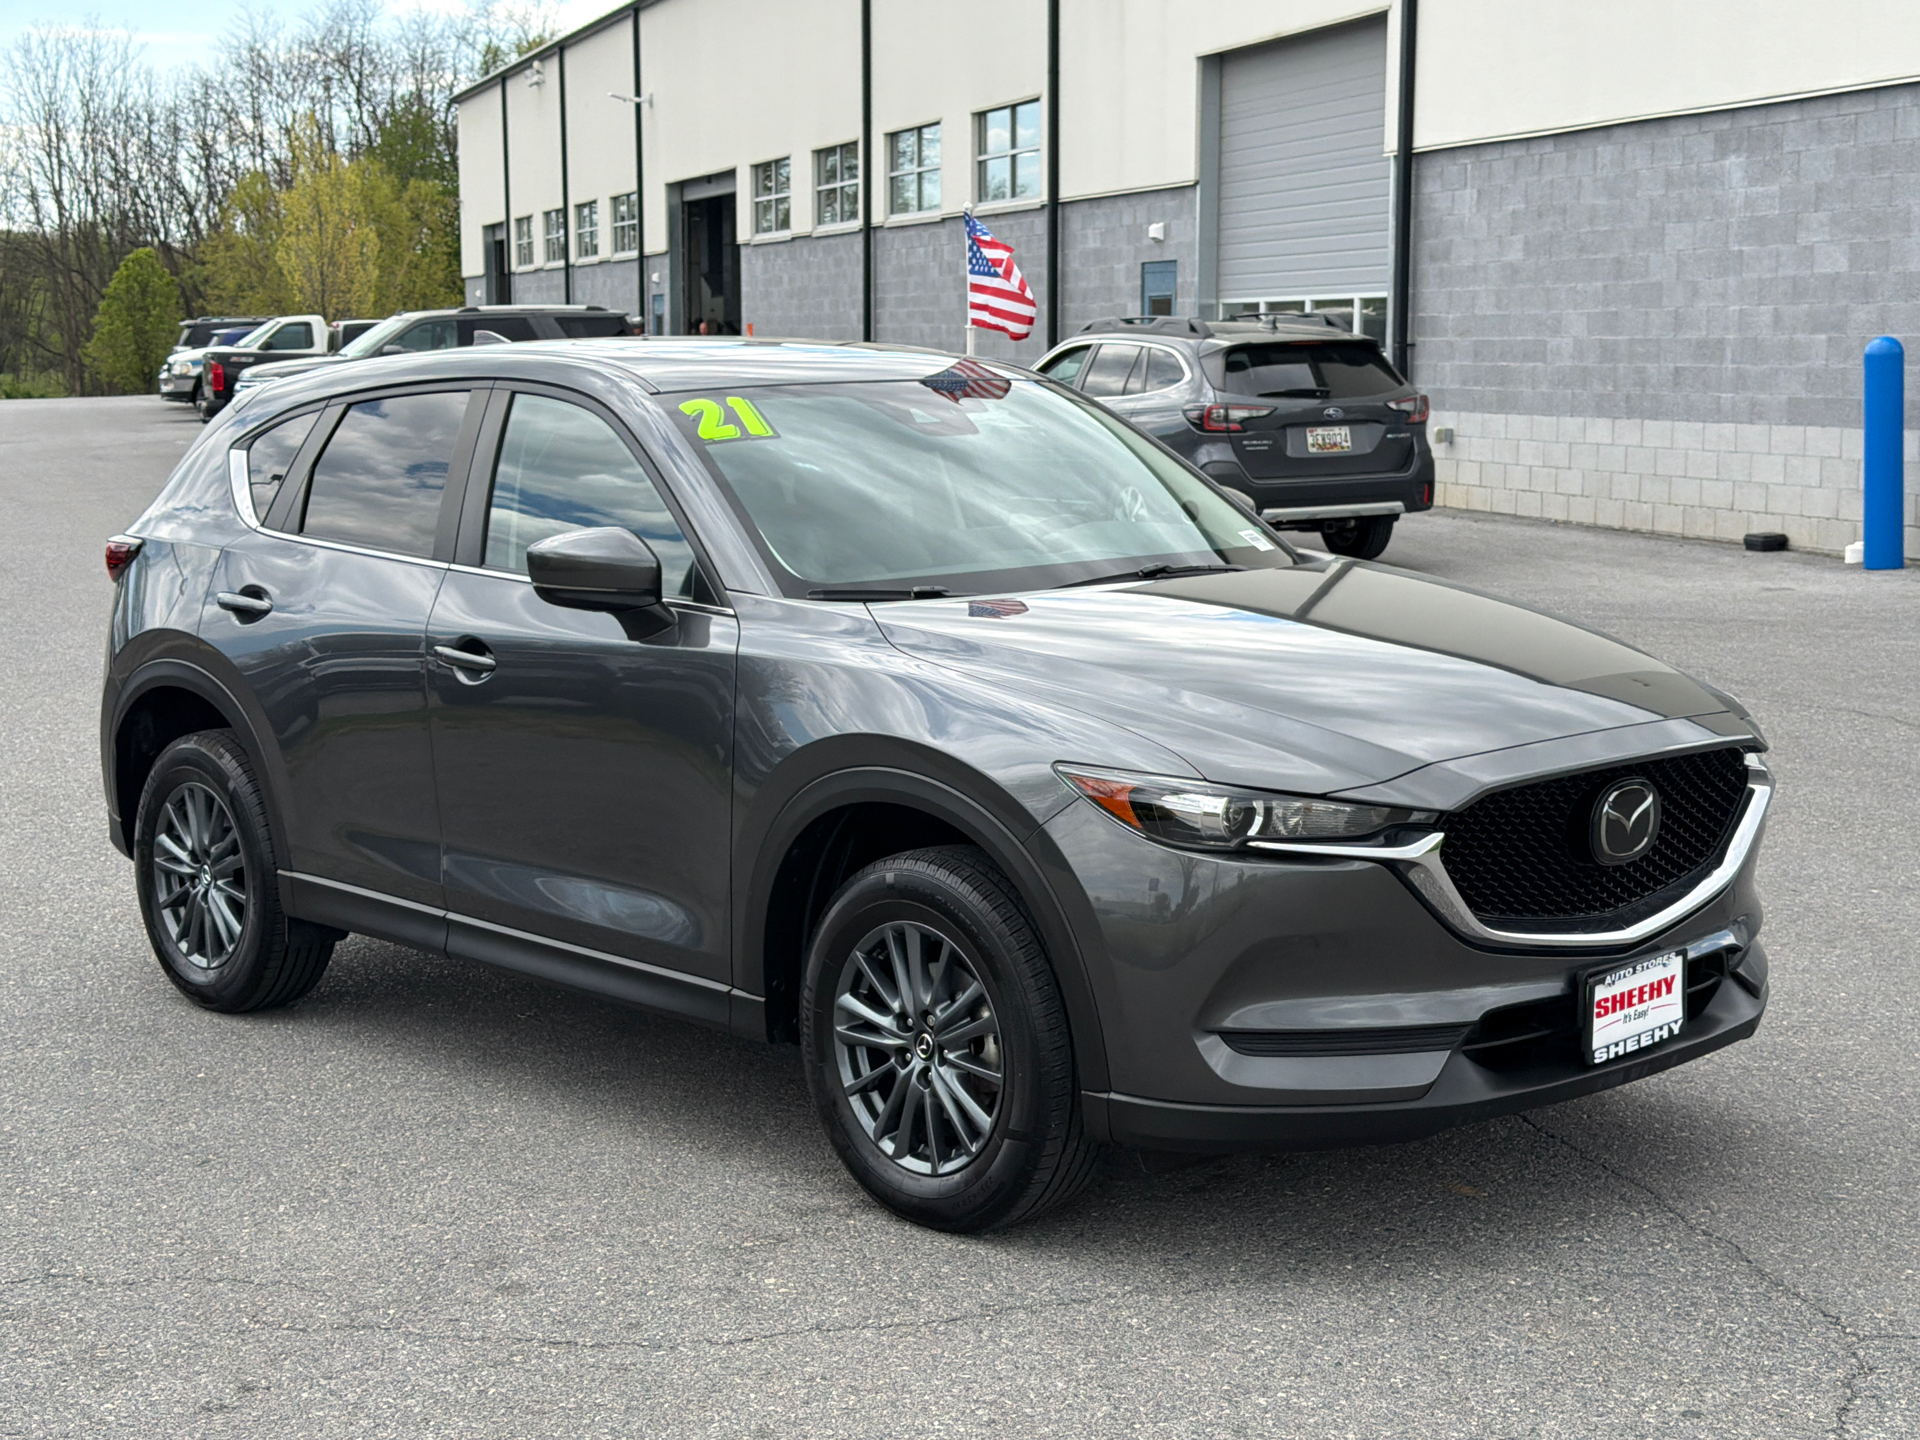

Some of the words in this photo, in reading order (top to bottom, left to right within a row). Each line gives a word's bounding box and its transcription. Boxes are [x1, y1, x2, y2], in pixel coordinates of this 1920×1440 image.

[678, 396, 774, 441] 21
[1604, 967, 1634, 986] AUTO
[1635, 952, 1677, 974] STORES
[1595, 974, 1676, 1019] SHEEHY
[1622, 1011, 1633, 1025] It's
[1633, 1005, 1650, 1021] Easy!
[1593, 1018, 1684, 1064] SHEEHY
